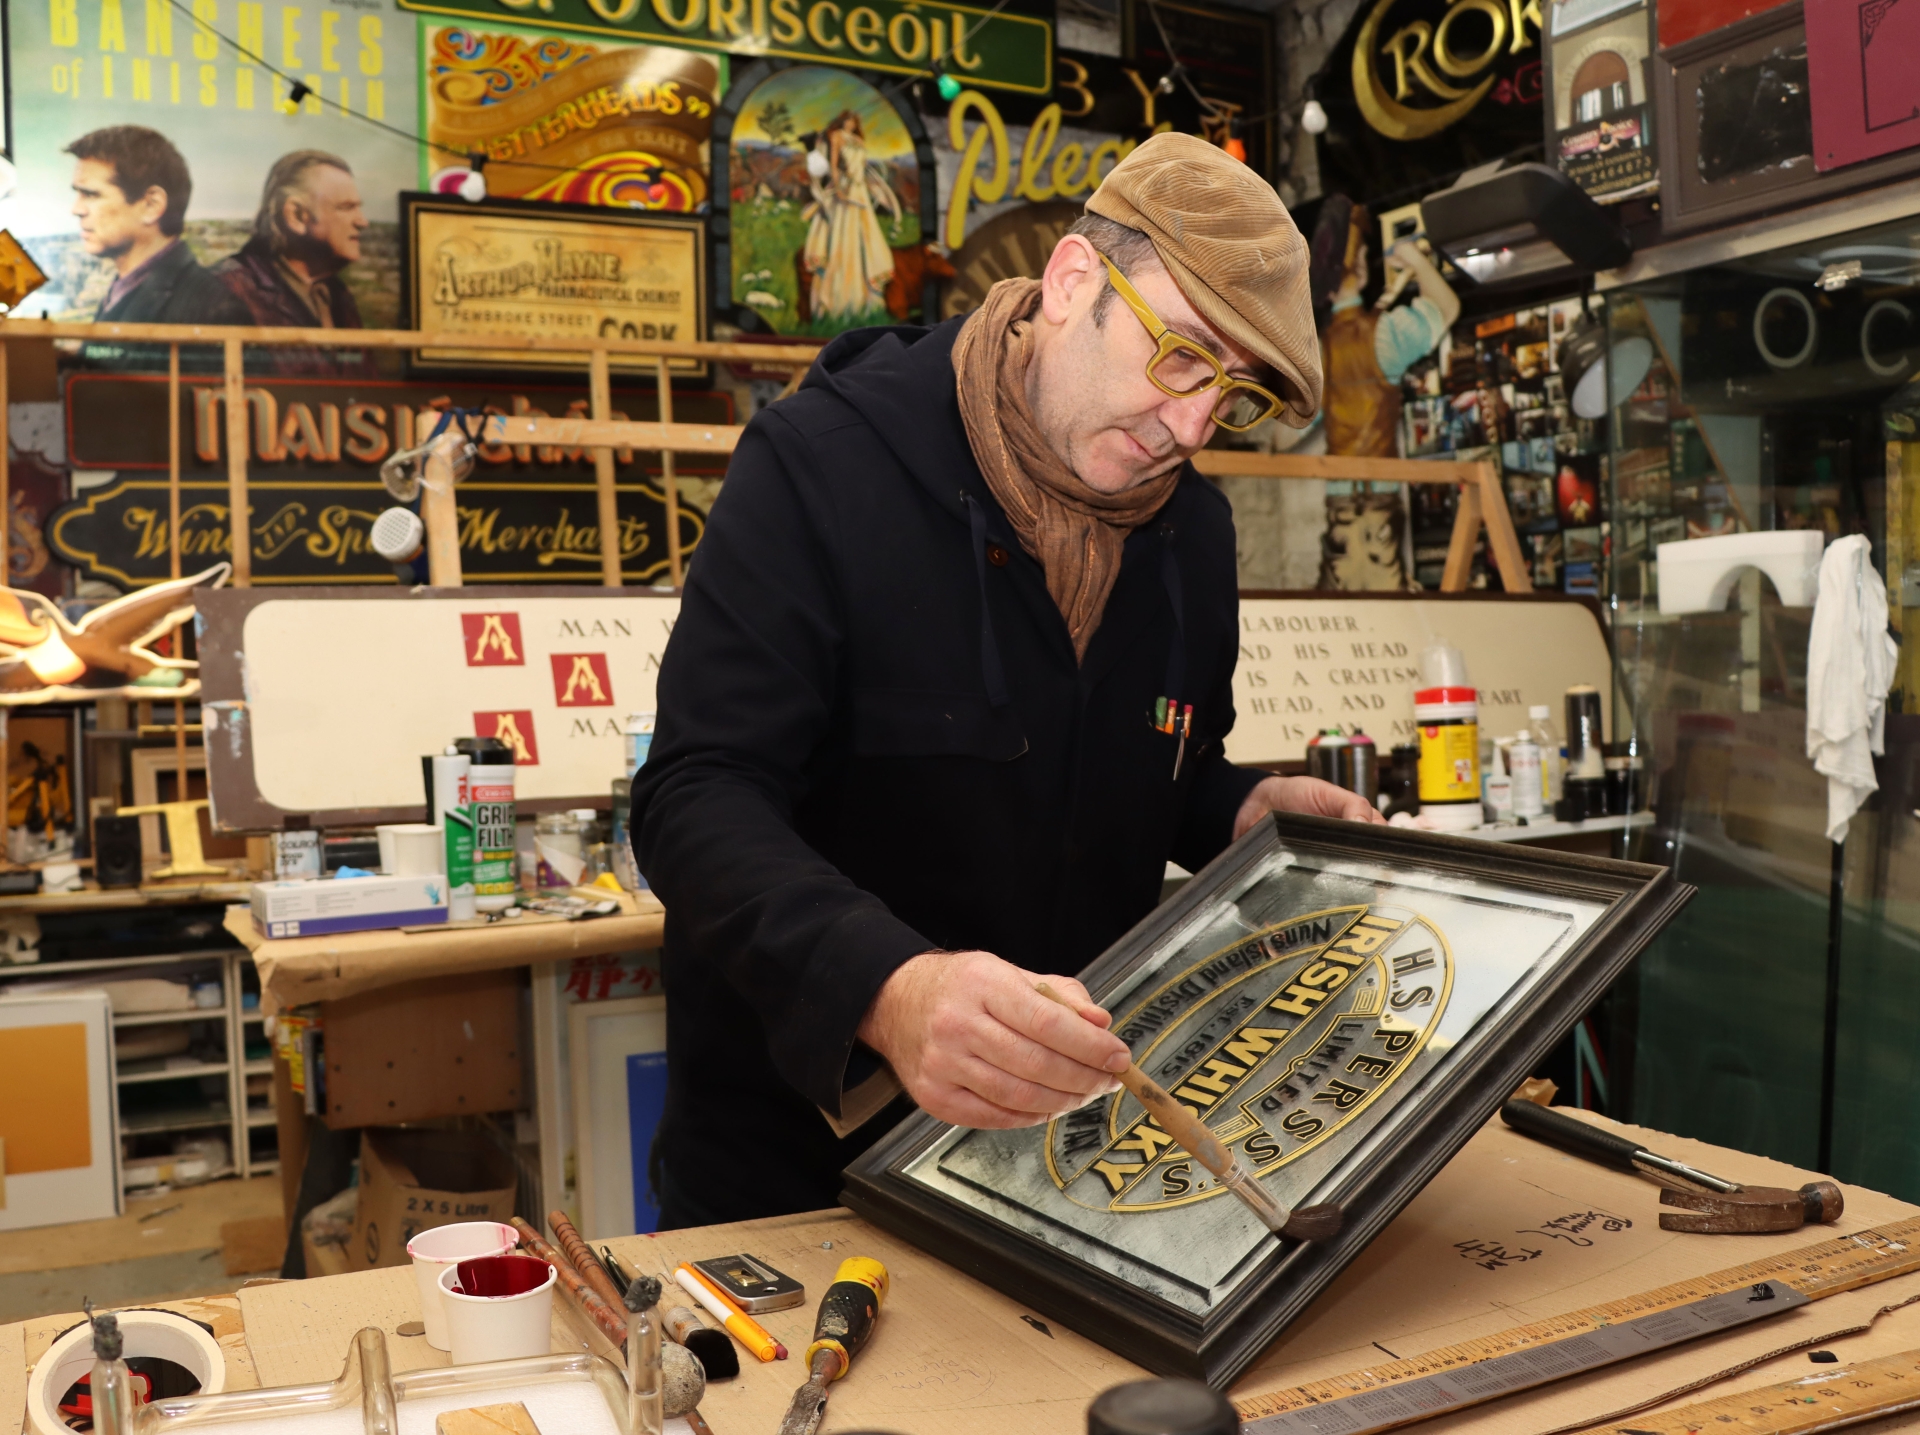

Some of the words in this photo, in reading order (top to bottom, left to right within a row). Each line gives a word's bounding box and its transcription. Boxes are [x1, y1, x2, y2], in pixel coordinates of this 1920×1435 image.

[50, 0, 384, 76] BANSHEES
[52, 58, 83, 99] of
[103, 55, 385, 119] INISHERIN
[539, 312, 594, 327] STREET
[455, 506, 650, 566] Merchat
[558, 618, 632, 637] MAN
[1238, 644, 1271, 660] ND
[1295, 643, 1330, 660] HIS
[1352, 641, 1409, 660] HEAD
[1247, 671, 1268, 688] IS
[1292, 669, 1310, 686] A
[1327, 667, 1421, 688] CRAFTSM
[1339, 695, 1386, 714] AND
[1477, 690, 1523, 706] EART
[570, 717, 632, 738] MA
[1282, 725, 1306, 742] IS
[1389, 721, 1416, 739] AR
[1269, 918, 1332, 950] Nuns
[1198, 939, 1271, 986] Island
[1269, 914, 1404, 1018] IRISH
[1261, 1022, 1365, 1112] LIMITED
[407, 1198, 417, 1210] 2
[440, 1201, 449, 1214] 5
[455, 1203, 489, 1216] Litre
